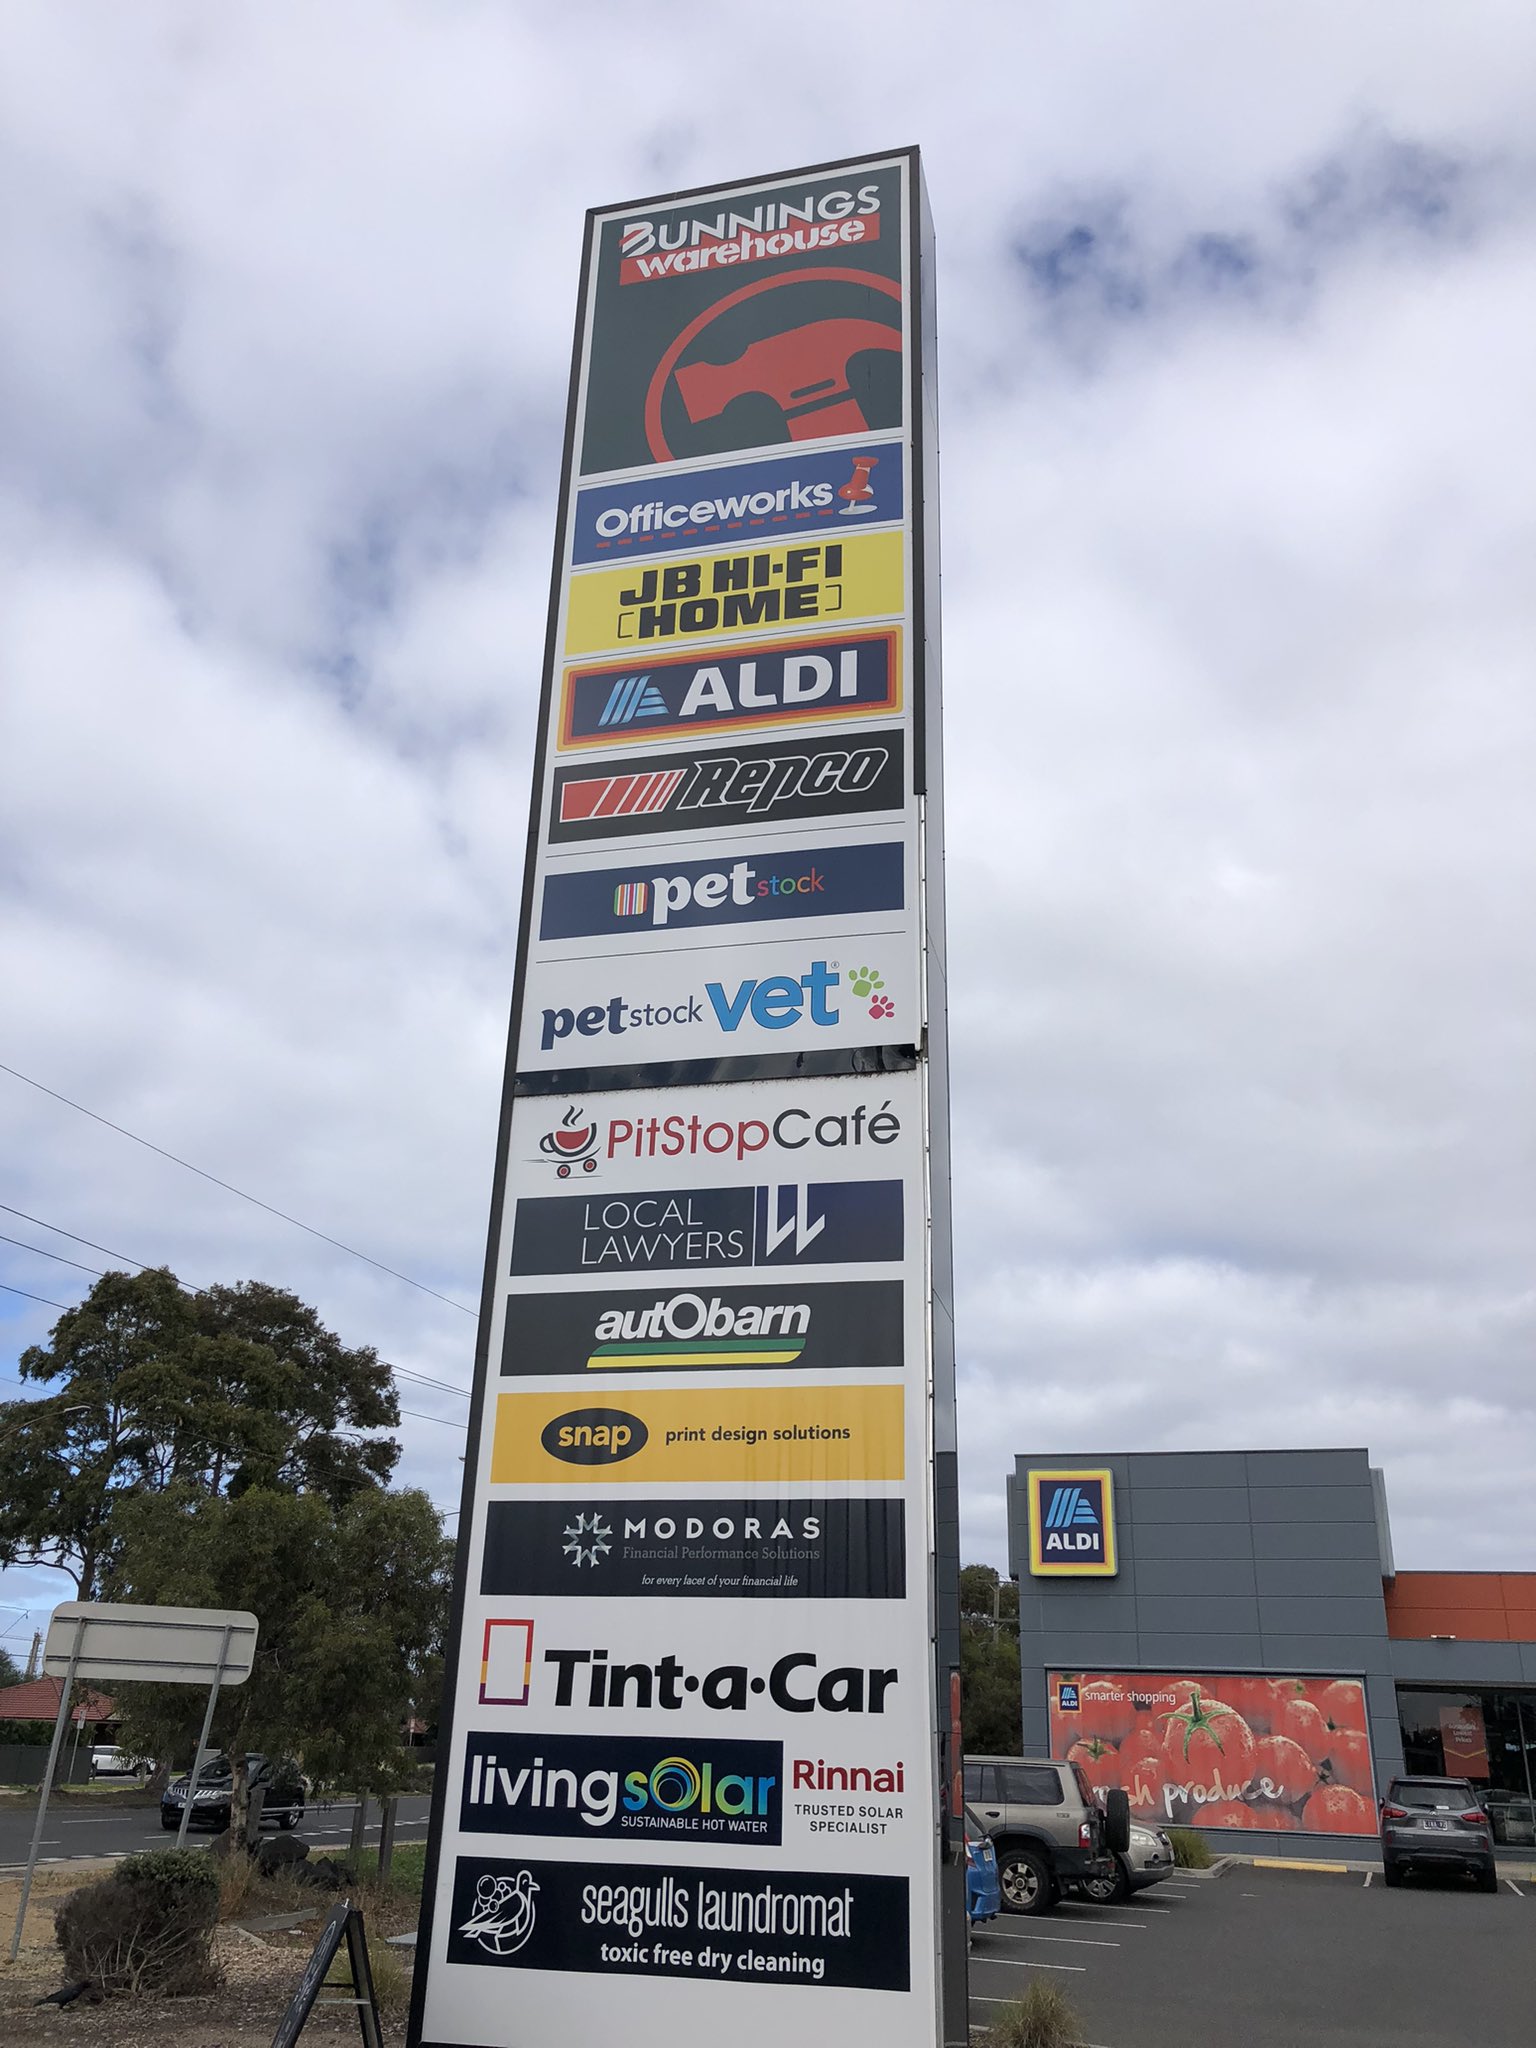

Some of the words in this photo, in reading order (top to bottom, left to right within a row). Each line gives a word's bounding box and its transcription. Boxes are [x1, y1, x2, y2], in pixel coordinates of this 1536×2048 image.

[621, 185, 880, 257] BUNNINGS
[637, 219, 866, 278] warehouse
[595, 481, 833, 538] Officeworks
[620, 564, 702, 606] JB
[678, 650, 858, 716] ALDI
[584, 1198, 703, 1230] LOCAL
[582, 1230, 743, 1264] LAWYERS
[558, 1424, 632, 1454] snap
[666, 1427, 706, 1445] print
[712, 1425, 767, 1445] design
[773, 1424, 850, 1440] solutions
[624, 1517, 820, 1540] MODORAS
[1046, 1532, 1100, 1550] ALDI
[623, 1546, 678, 1559] Financial
[681, 1547, 759, 1559] Performance
[762, 1547, 820, 1559] Solutions
[641, 1574, 655, 1585] for
[656, 1576, 681, 1587] every
[683, 1574, 705, 1585] facet
[707, 1575, 719, 1585] of
[719, 1577, 740, 1587] your
[742, 1575, 781, 1586] financial
[784, 1575, 798, 1586] life
[1085, 1690, 1124, 1702] smarter
[1127, 1691, 1176, 1705] shopping
[793, 1759, 904, 1793] Rinnai
[1163, 1768, 1284, 1818] produce
[621, 1815, 699, 1830] SUSTAINABLE
[702, 1818, 726, 1831] HOT
[729, 1819, 768, 1833] WATER
[795, 1804, 855, 1817] TRUSTED
[858, 1806, 904, 1819] SOLAR
[809, 1821, 887, 1835] SPECIALIST
[581, 1876, 689, 1938] seagulls
[697, 1881, 854, 1938] laundromat
[601, 1942, 649, 1963] toxic
[653, 1943, 693, 1966] free
[697, 1947, 732, 1973] dry
[737, 1949, 825, 1979] cleaning
